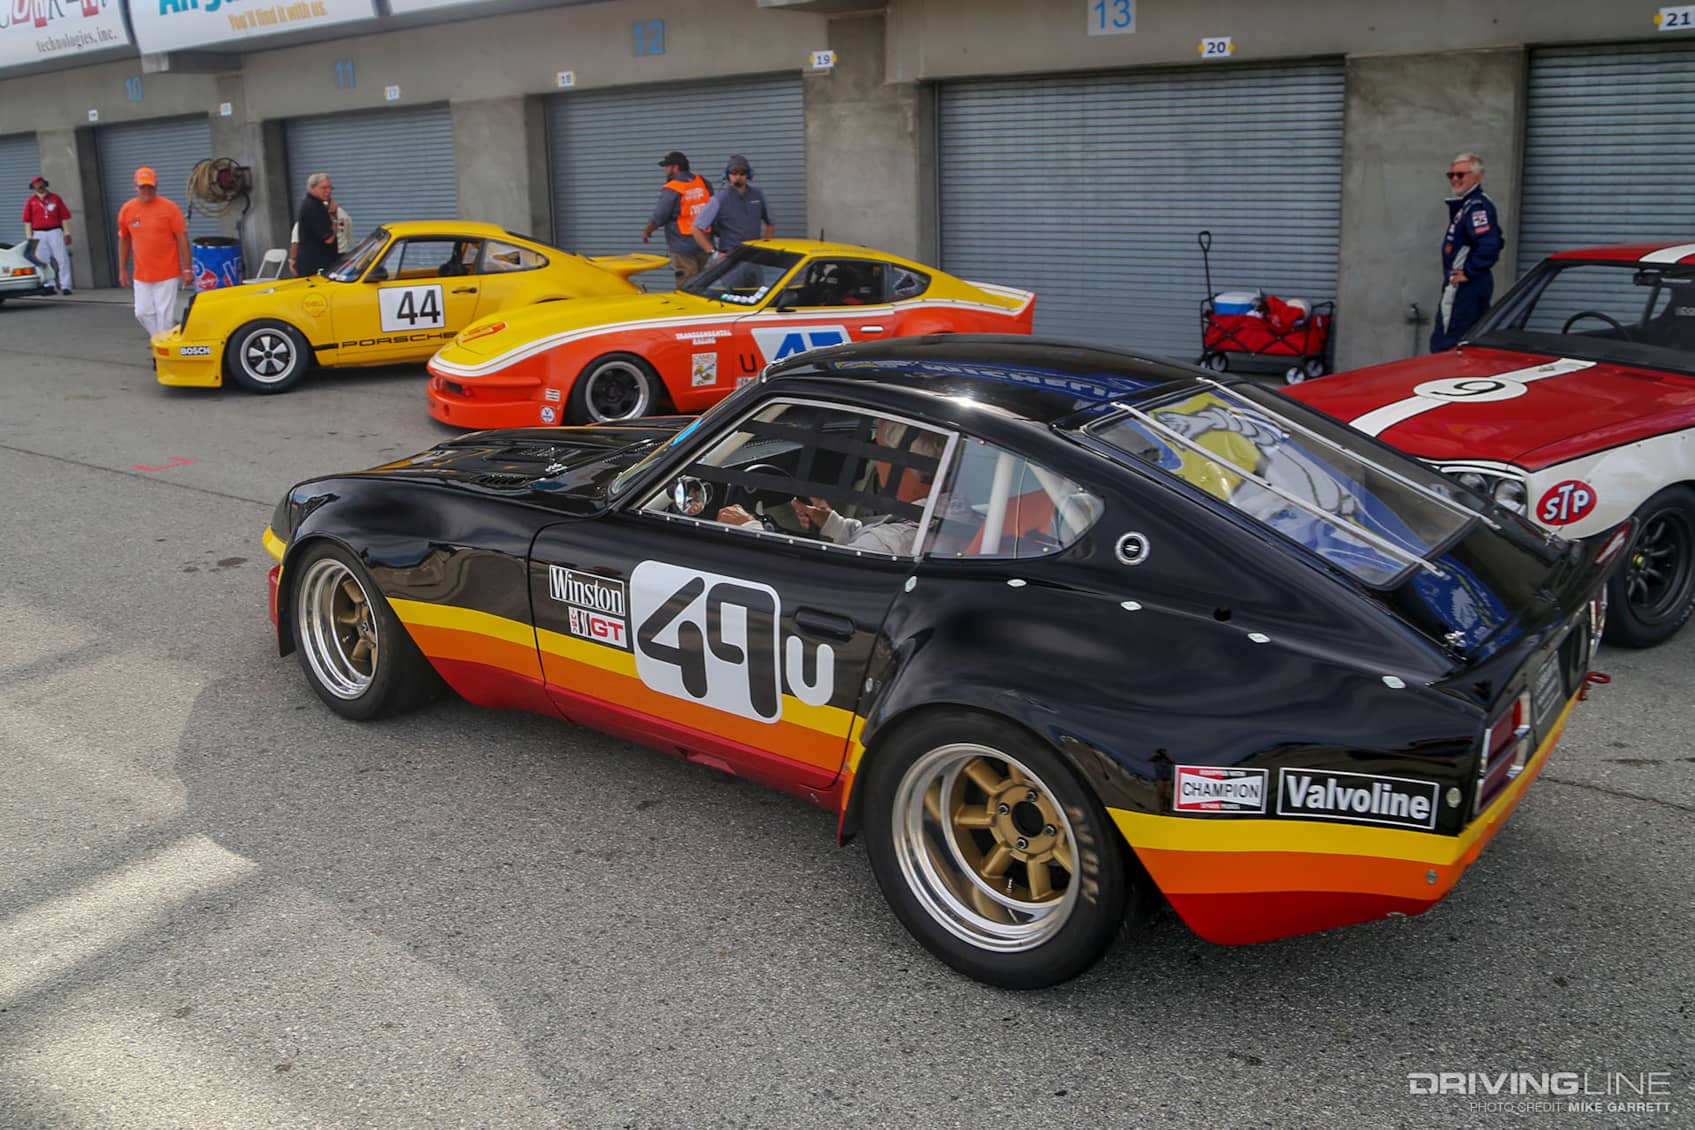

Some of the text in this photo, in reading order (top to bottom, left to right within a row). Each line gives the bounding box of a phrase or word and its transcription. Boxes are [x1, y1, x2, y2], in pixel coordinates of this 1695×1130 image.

[1094, 0, 1131, 29] 13
[1666, 12, 1692, 27] 21
[36, 26, 118, 53] technologies, inc.
[633, 20, 665, 56] 12
[1207, 41, 1227, 54] 20
[817, 54, 830, 65] 19
[336, 60, 355, 90] 11
[396, 289, 442, 325] 44
[180, 346, 211, 356] BOSCH
[342, 331, 459, 348] PORSCHE
[739, 354, 757, 373] U
[1543, 484, 1589, 520] STP
[551, 566, 624, 615] Winston
[591, 617, 624, 641] GT
[637, 576, 778, 718] 49
[1182, 781, 1260, 798] CHAMPION
[1286, 775, 1431, 820] Valvoline
